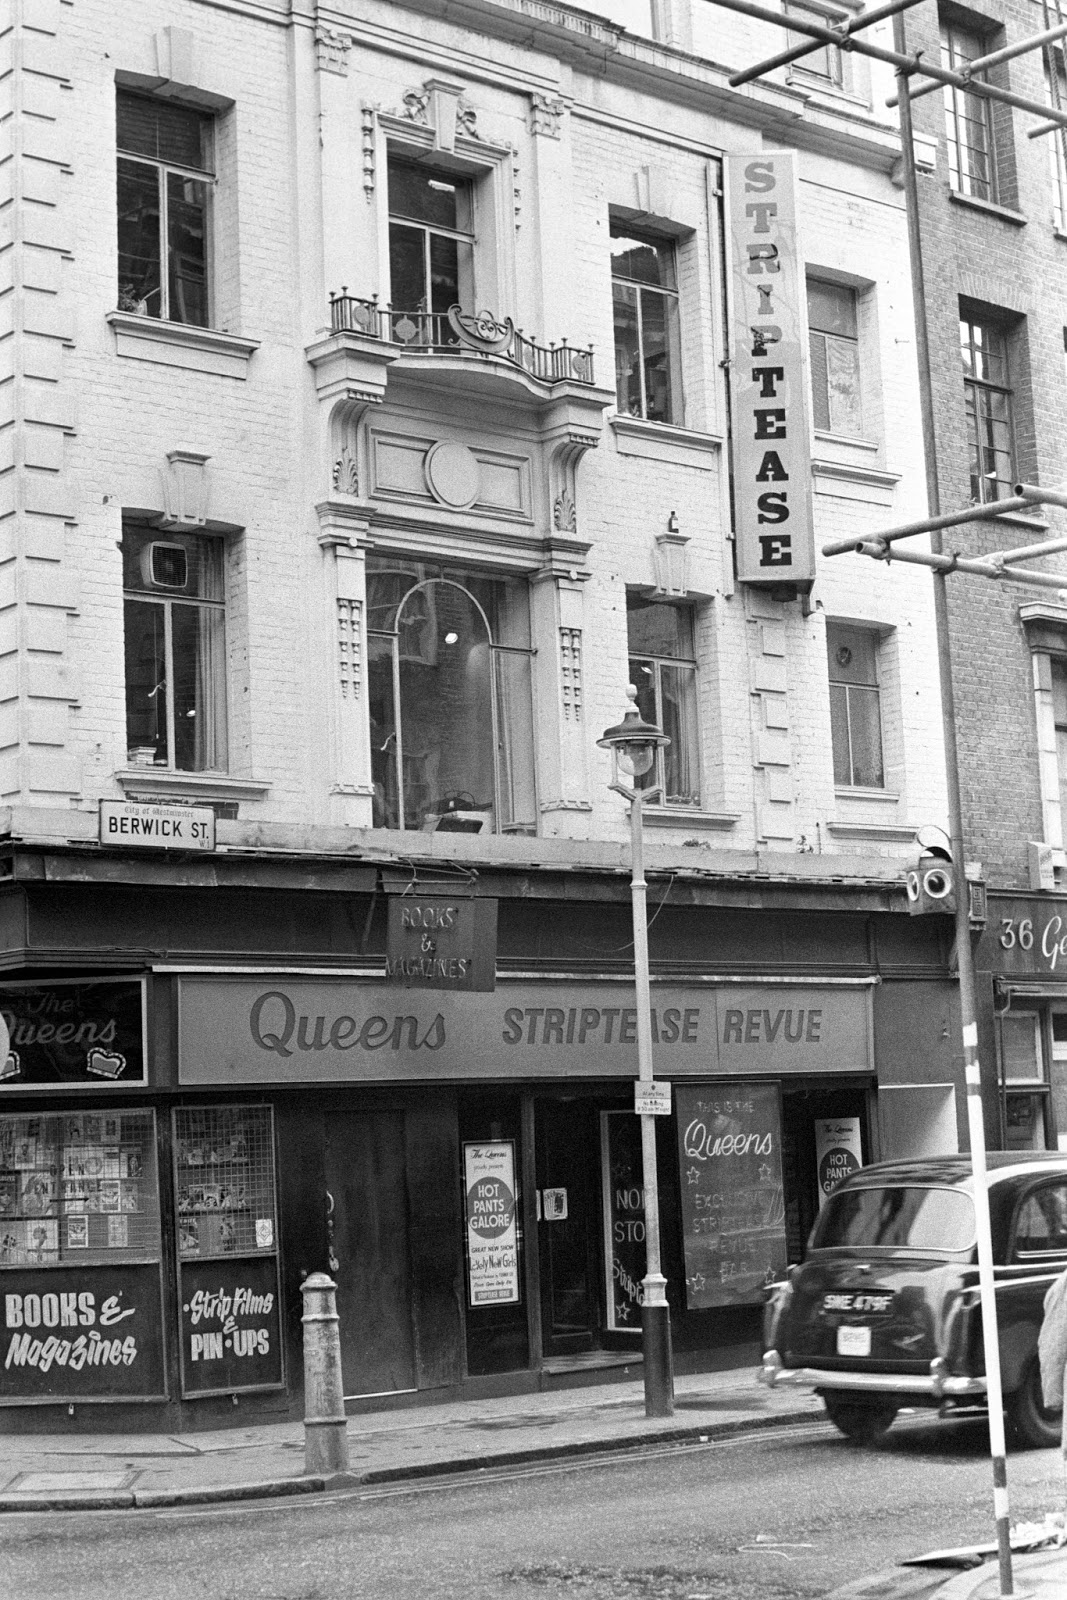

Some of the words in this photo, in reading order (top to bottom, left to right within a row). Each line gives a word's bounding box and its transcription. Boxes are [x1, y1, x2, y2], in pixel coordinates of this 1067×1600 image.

[744, 161, 793, 567] STRIPTEASE
[124, 806, 140, 816] City
[142, 807, 150, 815] of
[109, 816, 182, 837] BERWICK
[191, 822, 209, 839] ST.
[401, 907, 453, 928] BOOKS
[421, 933, 436, 952] &
[1001, 918, 1034, 950] 36
[249, 990, 447, 1058] Queens
[502, 1007, 700, 1045] STRIPTESE
[723, 1008, 823, 1044] REVUE
[684, 1118, 772, 1161] Queens
[829, 1153, 848, 1166] HOT
[477, 1184, 499, 1197] HOT
[473, 1199, 505, 1213] PANTS
[470, 1213, 510, 1229] GALORE
[614, 1221, 645, 1243] STO
[4, 1292, 96, 1328] BOOKS
[100, 1290, 136, 1326] &
[190, 1287, 233, 1325] Strip
[233, 1287, 275, 1317] Films
[222, 1314, 239, 1334] &
[4, 1330, 138, 1372] Magazines
